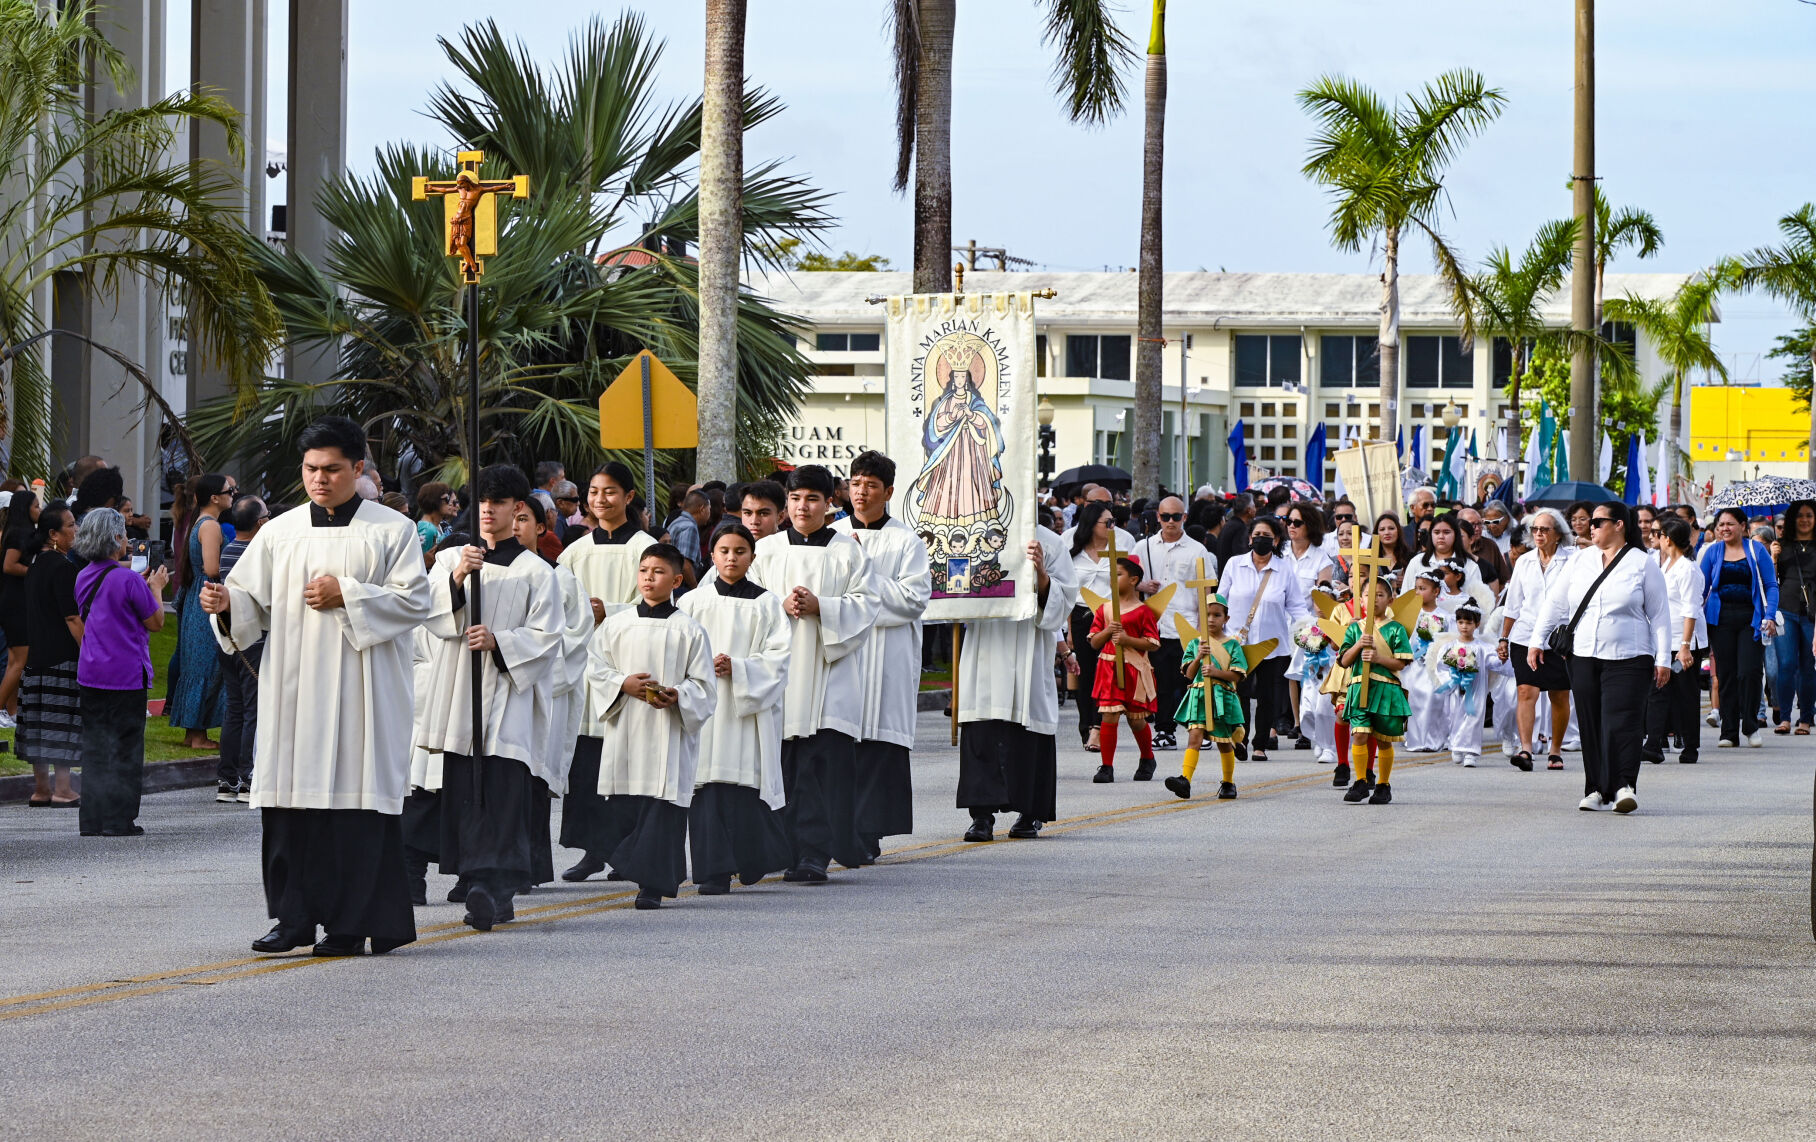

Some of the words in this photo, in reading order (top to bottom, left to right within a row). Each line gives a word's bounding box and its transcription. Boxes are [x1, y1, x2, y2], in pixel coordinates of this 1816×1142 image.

[911, 356, 925, 401] SANTA
[919, 319, 979, 351] MARIAN
[982, 327, 1011, 398] KAMALEN
[780, 444, 868, 459] NGRESS
